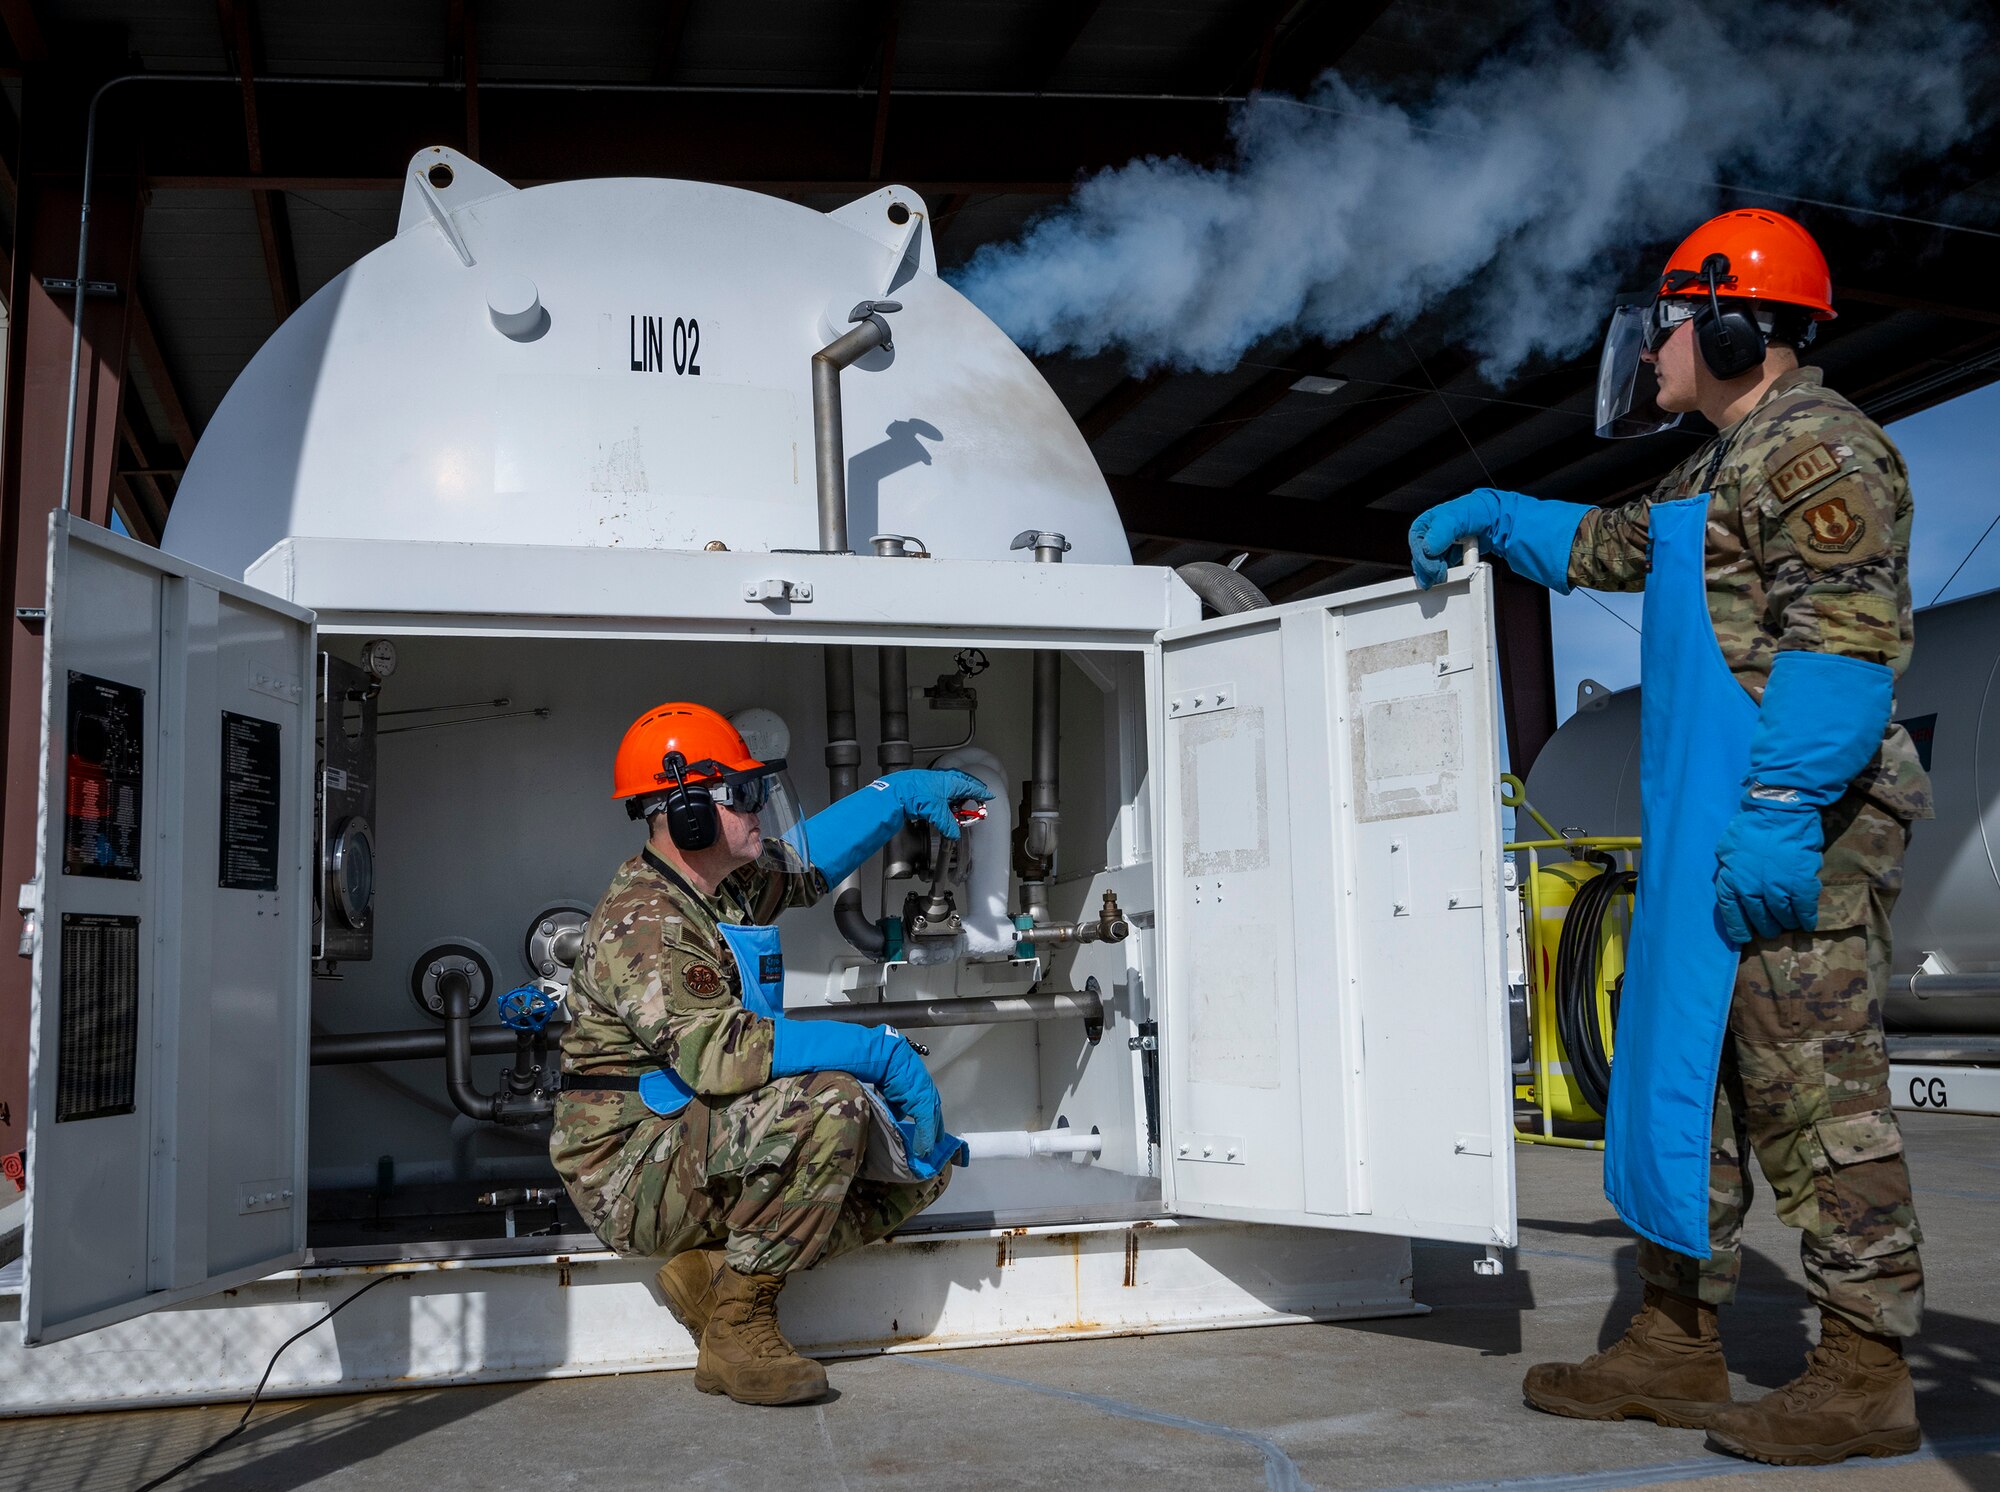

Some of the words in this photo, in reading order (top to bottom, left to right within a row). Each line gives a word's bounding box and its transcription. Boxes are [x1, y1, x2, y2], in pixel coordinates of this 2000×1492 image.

[631, 315, 662, 373] LIN
[673, 317, 701, 375] 02
[1777, 454, 1831, 492] POL
[1912, 1077, 1948, 1107] CG
